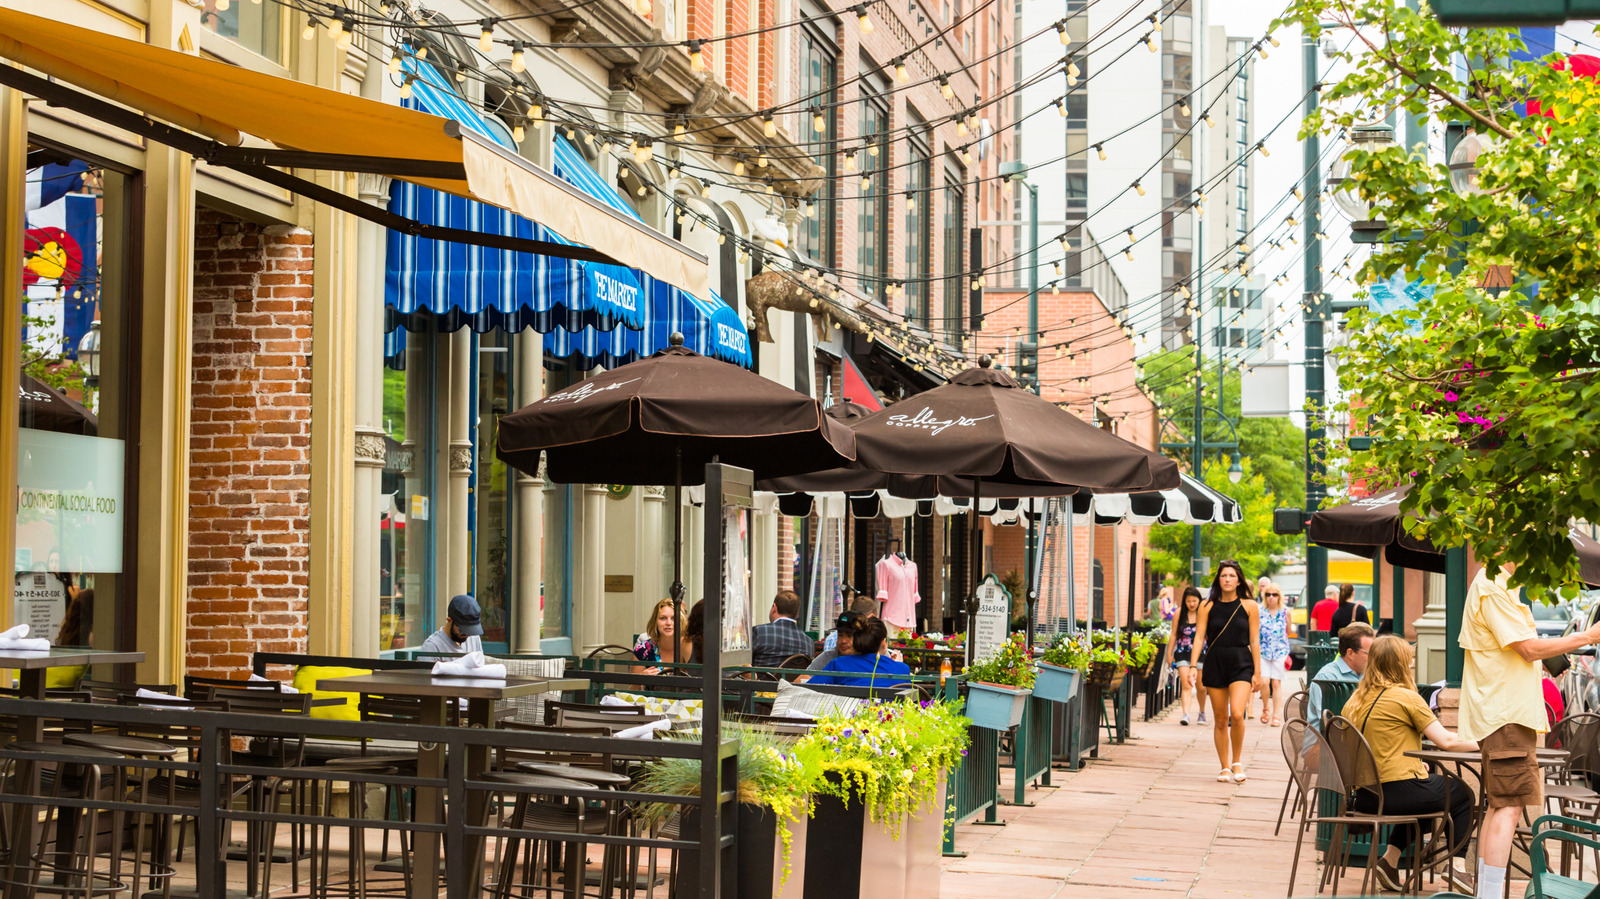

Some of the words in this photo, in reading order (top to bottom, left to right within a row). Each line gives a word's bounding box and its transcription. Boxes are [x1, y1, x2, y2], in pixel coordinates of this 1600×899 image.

[20, 491, 69, 511] CONTINENTAL
[69, 495, 95, 512] SOCIAL
[96, 497, 117, 514] FOOD
